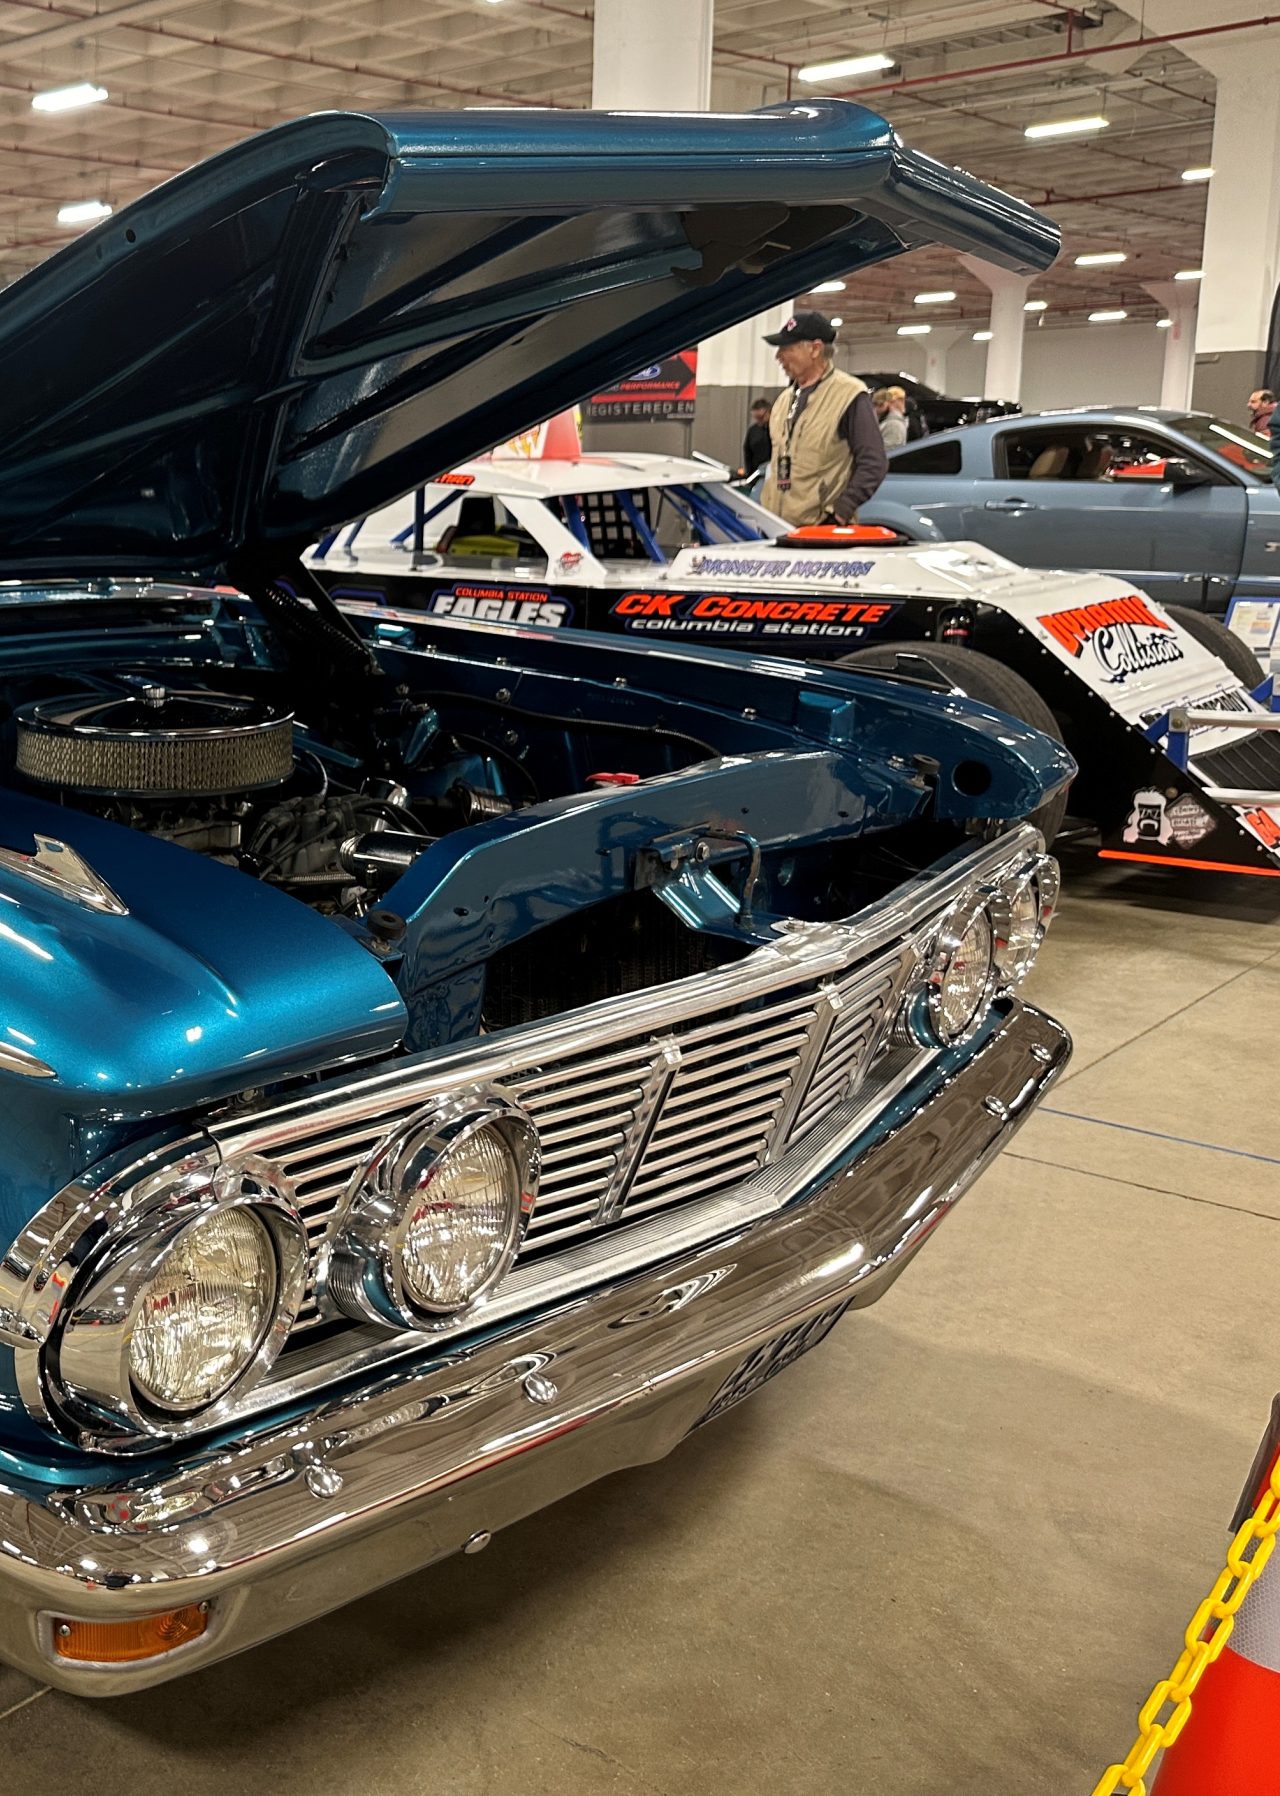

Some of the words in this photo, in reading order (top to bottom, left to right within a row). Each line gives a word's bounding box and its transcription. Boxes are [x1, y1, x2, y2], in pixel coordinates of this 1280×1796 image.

[455, 587, 504, 600] COLUMBIA
[507, 592, 548, 602] STATION
[615, 593, 685, 615] CK
[692, 595, 892, 622] CONCRETE
[432, 595, 567, 628] EAGLES
[1036, 594, 1173, 658] DYNAMIC
[631, 618, 754, 633] columbia
[762, 623, 864, 637] station
[1092, 622, 1184, 676] Collision
